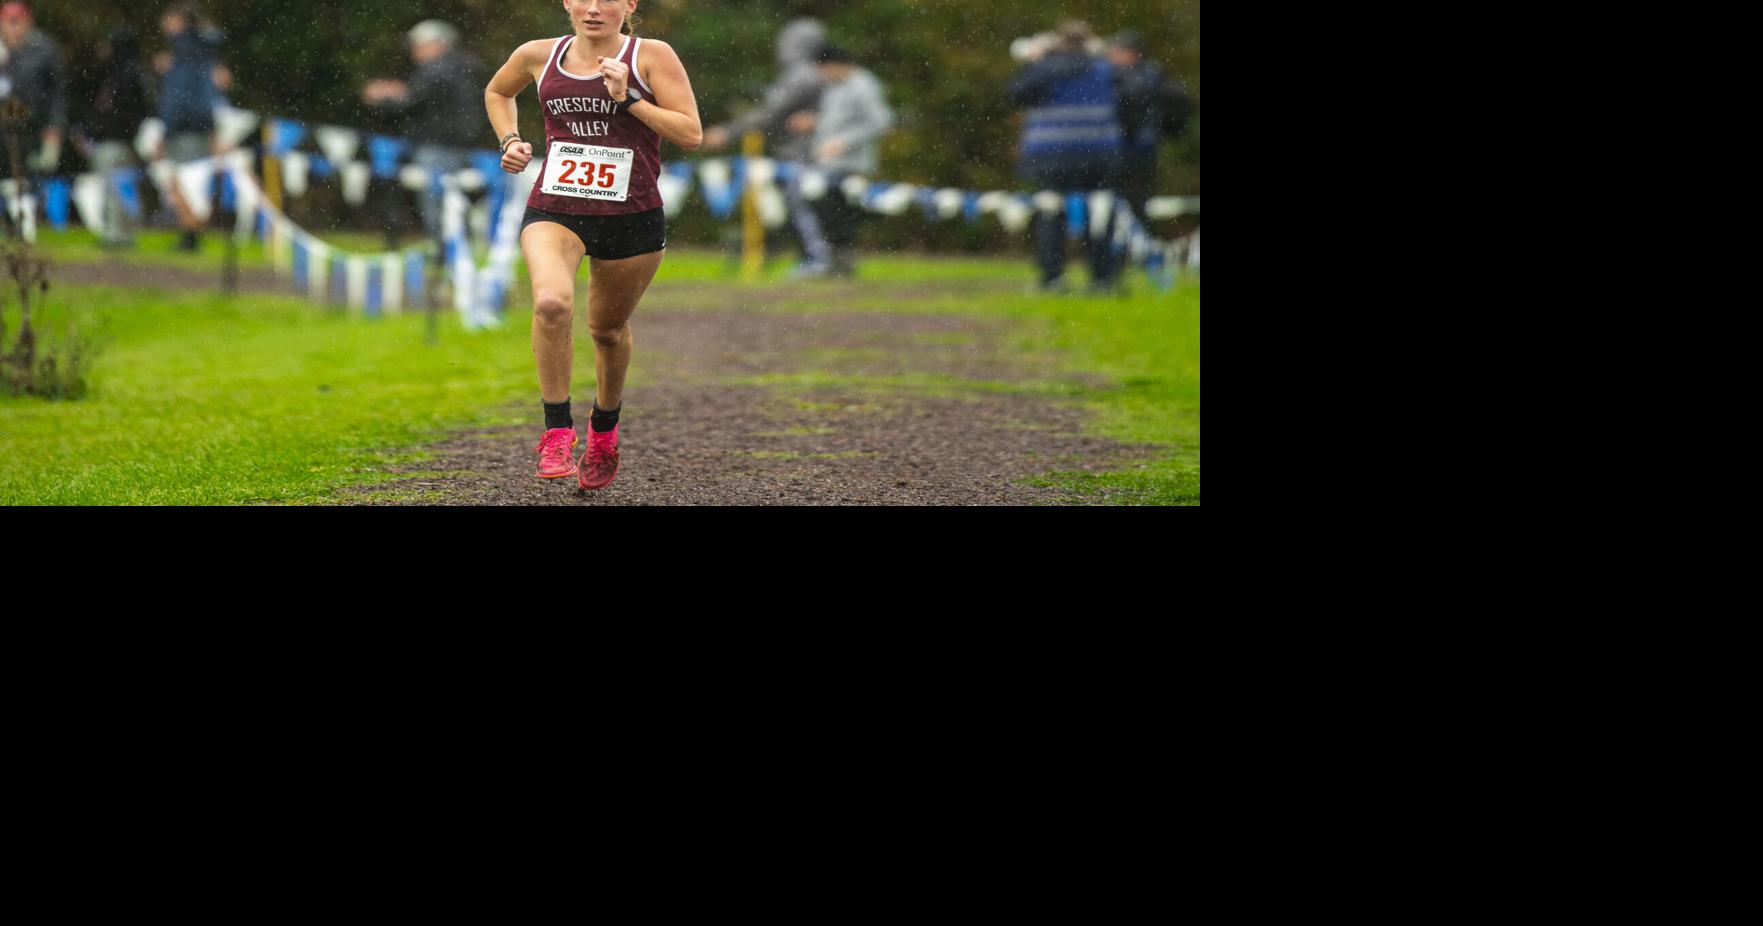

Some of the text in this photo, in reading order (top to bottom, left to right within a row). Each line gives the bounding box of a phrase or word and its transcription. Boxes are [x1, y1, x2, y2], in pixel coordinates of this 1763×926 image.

[560, 146, 584, 155] OSAA
[589, 148, 625, 158] OnPoint
[558, 160, 616, 188] 235
[552, 185, 578, 193] CROSS
[580, 188, 618, 197] COUNTRY
